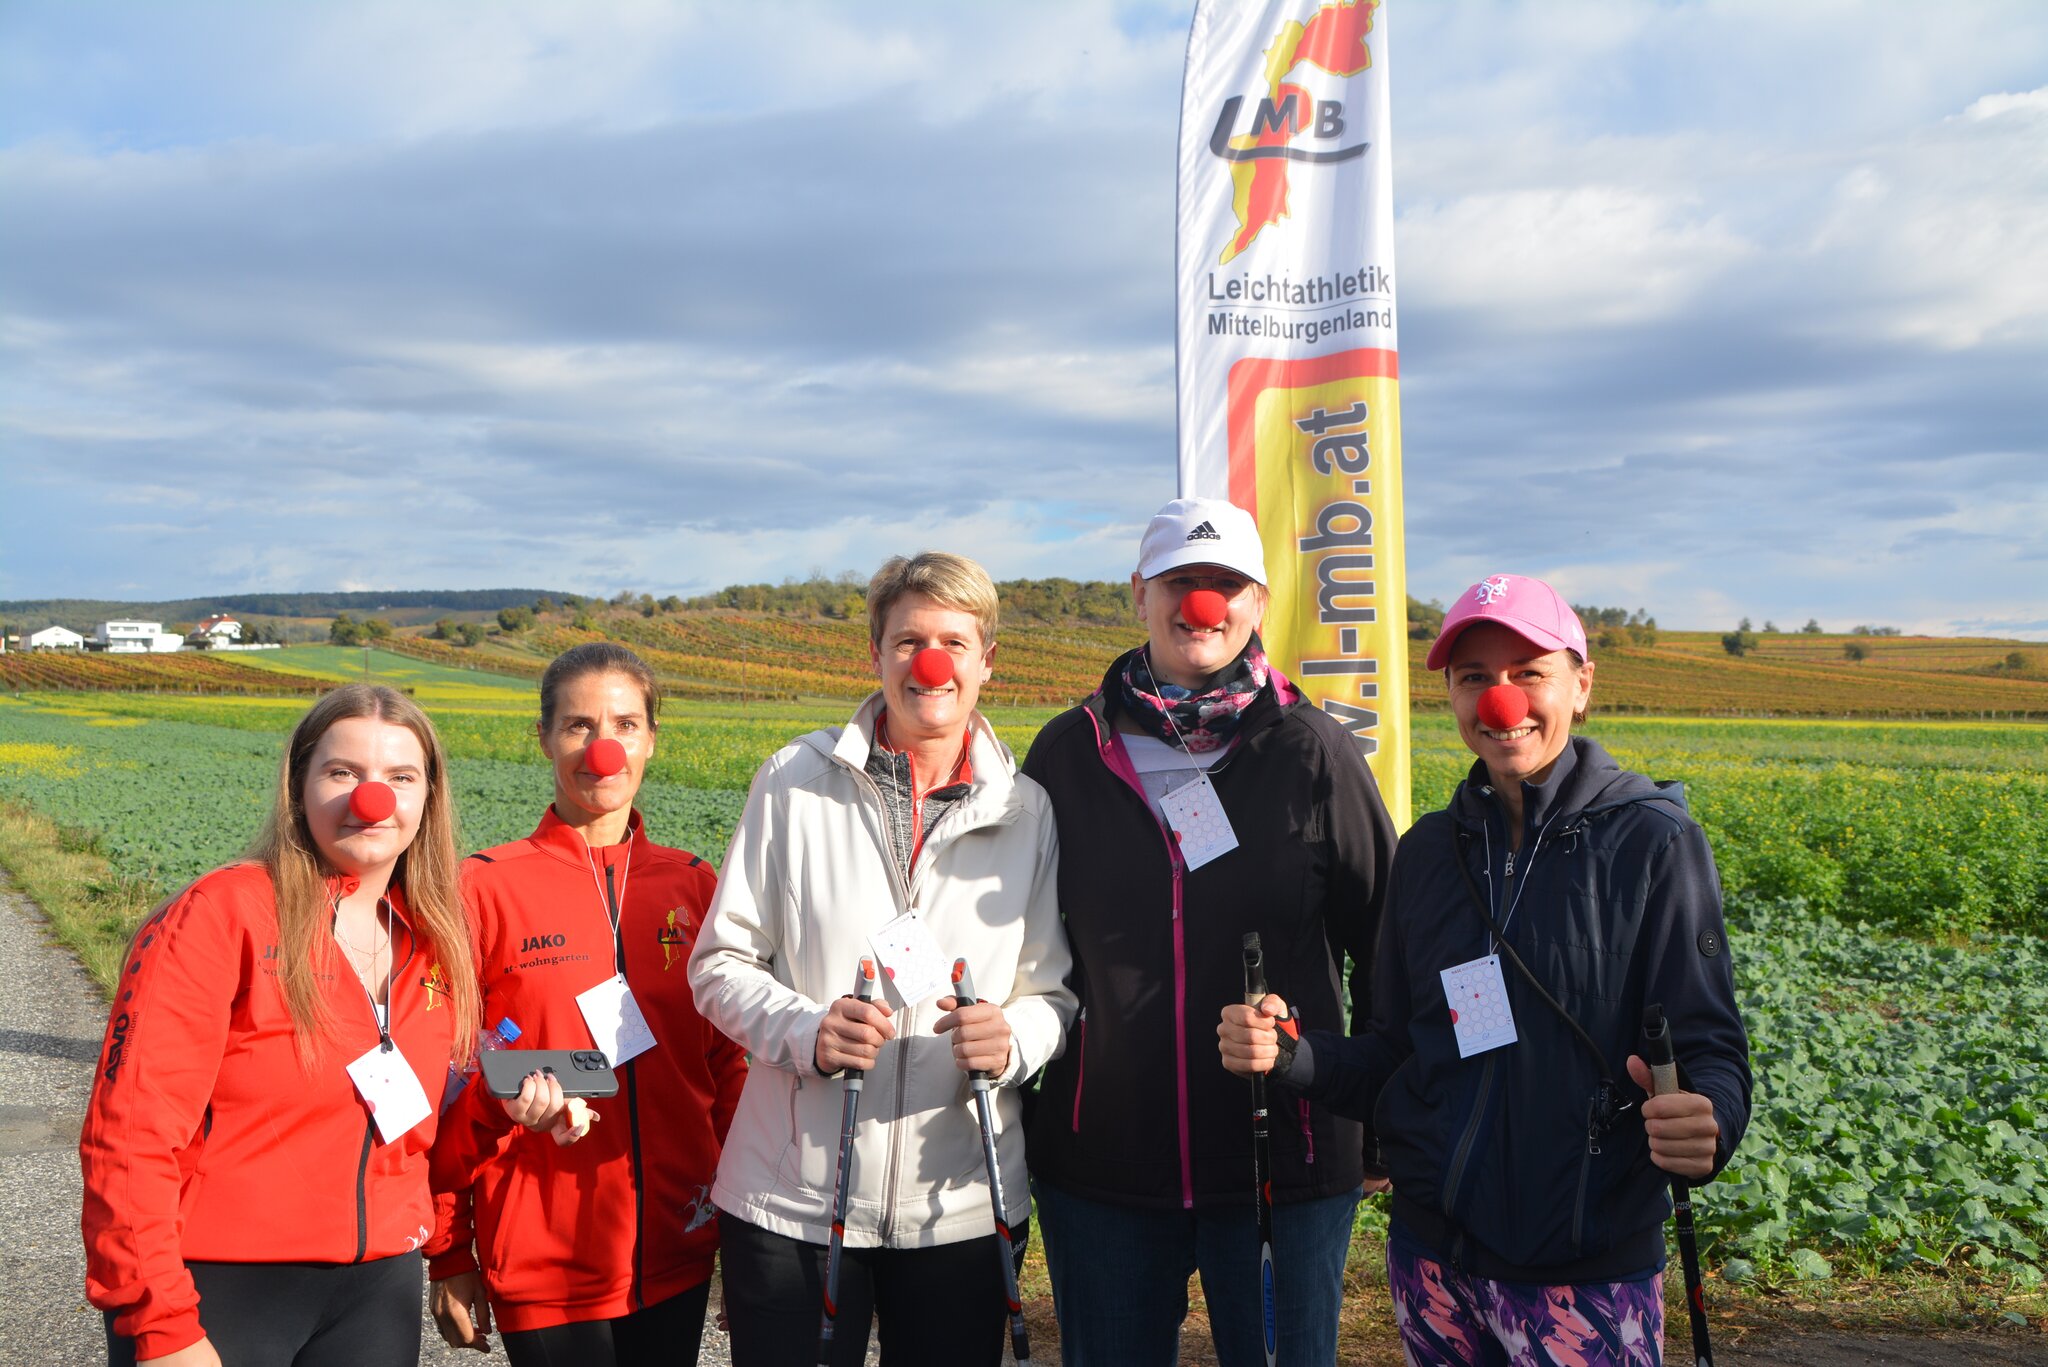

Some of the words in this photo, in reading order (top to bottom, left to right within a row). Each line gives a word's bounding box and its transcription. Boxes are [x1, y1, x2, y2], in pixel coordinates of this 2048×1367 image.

[1209, 94, 1370, 163] LMB
[1208, 266, 1391, 304] Leichtathletik
[1208, 308, 1392, 344] Mittelburgenland
[1187, 532, 1221, 541] adidas
[521, 934, 566, 953] JAKO
[120, 1011, 139, 1066] Burgenland
